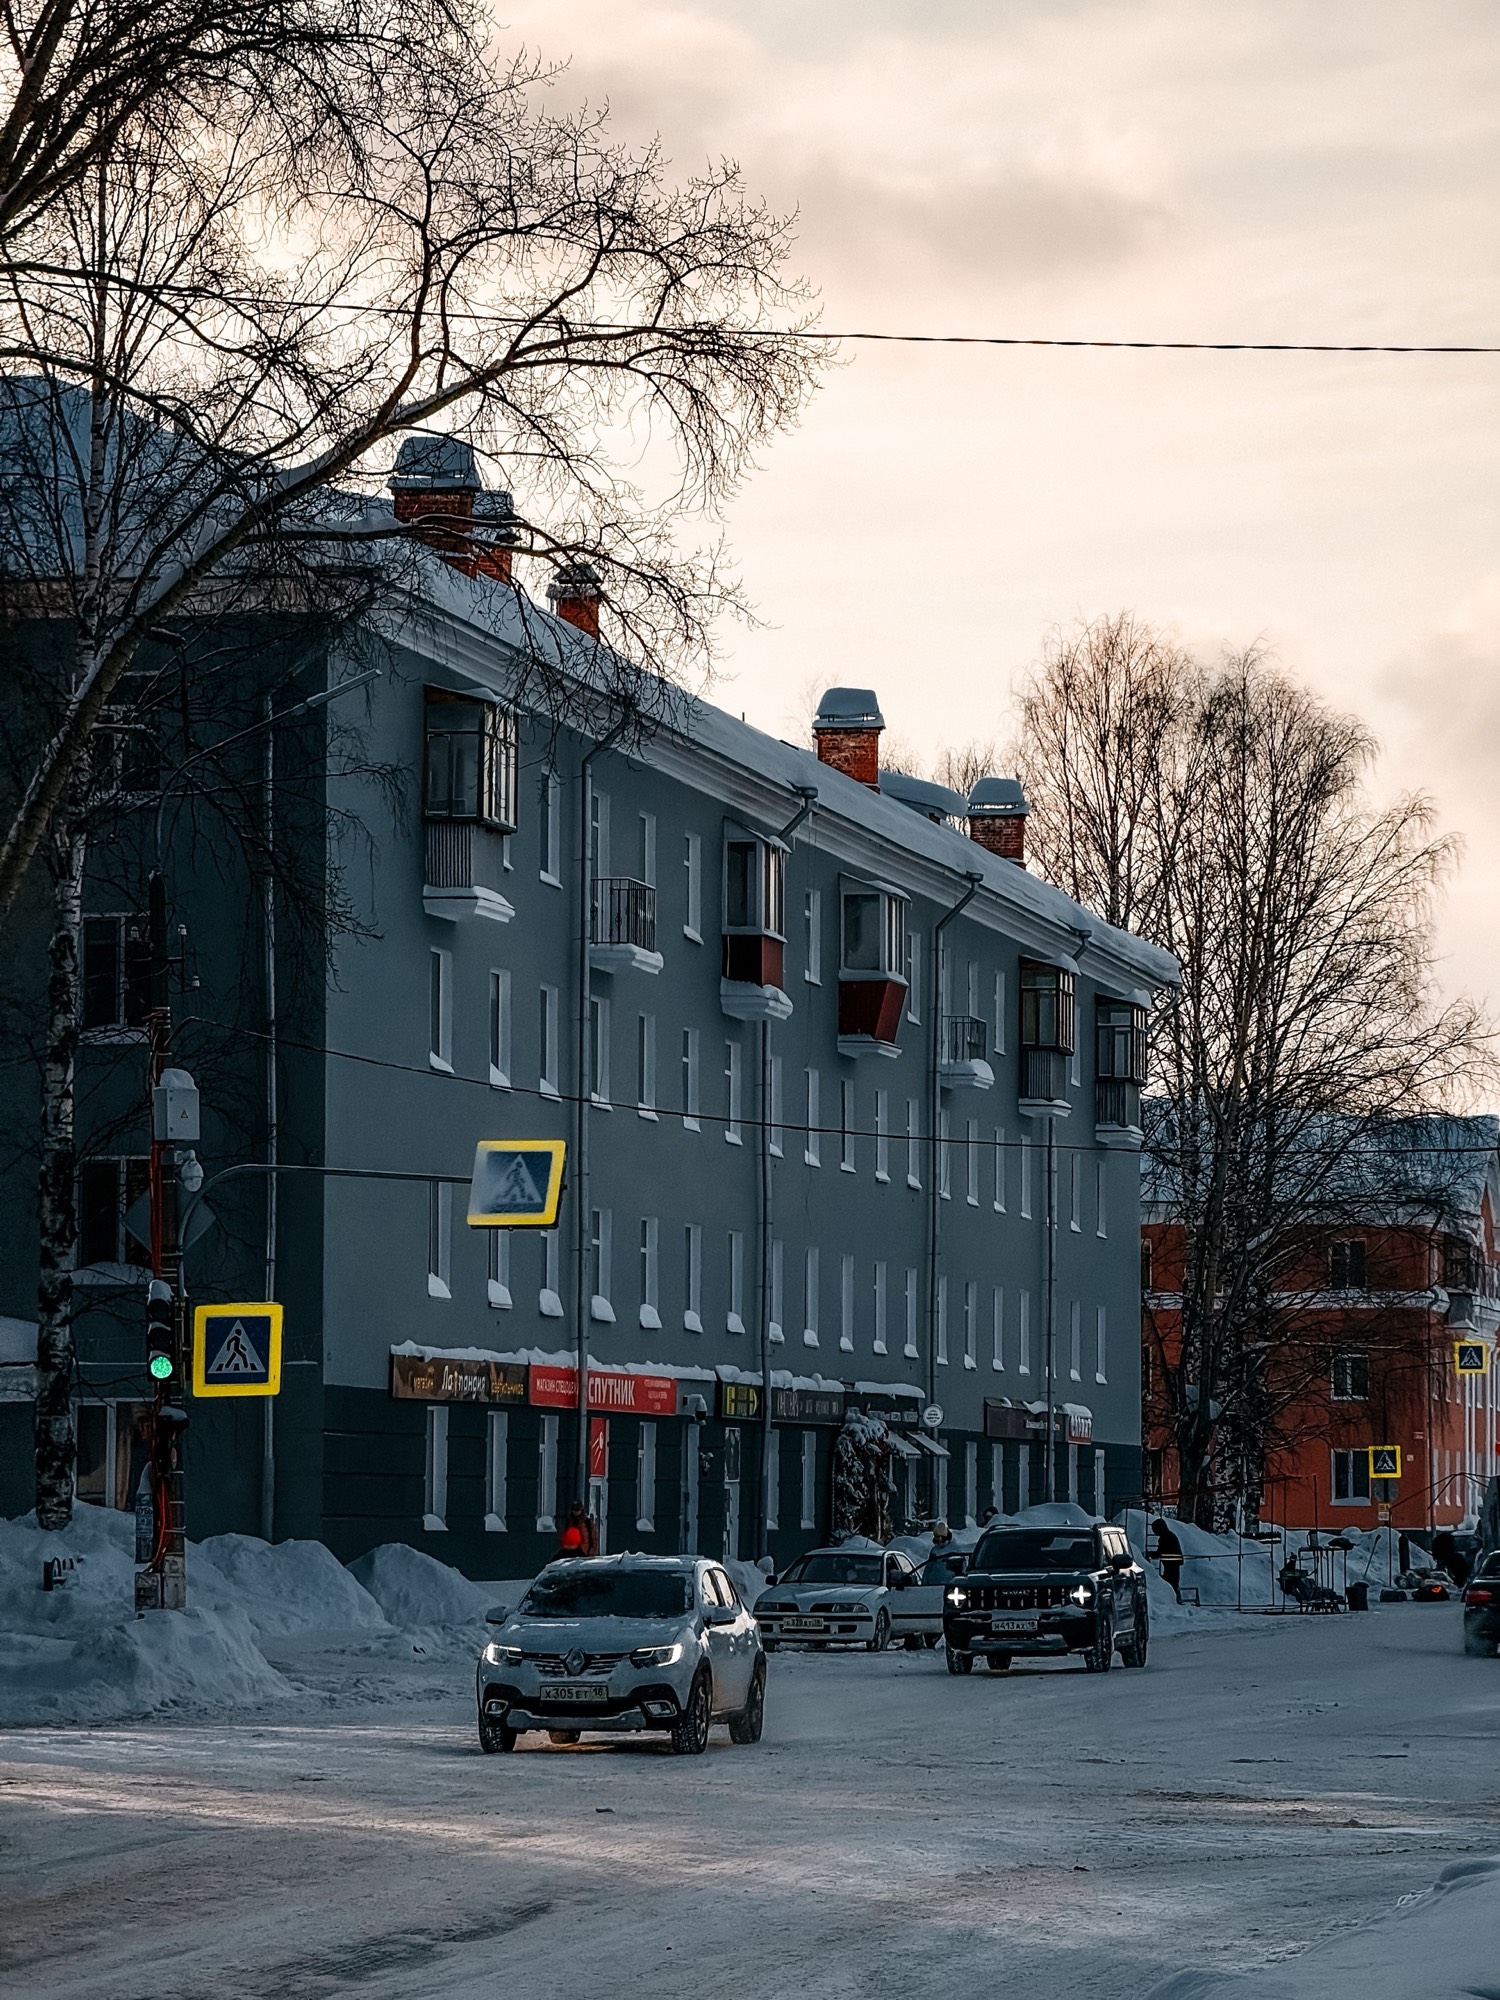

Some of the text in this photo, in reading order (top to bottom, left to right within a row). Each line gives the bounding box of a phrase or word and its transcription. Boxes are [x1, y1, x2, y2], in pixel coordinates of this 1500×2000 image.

[536, 1378, 555, 1392] МАГАЗИН
[588, 1376, 636, 1406] СПУТНИК
[545, 1688, 589, 1699] Х305ЕТ
